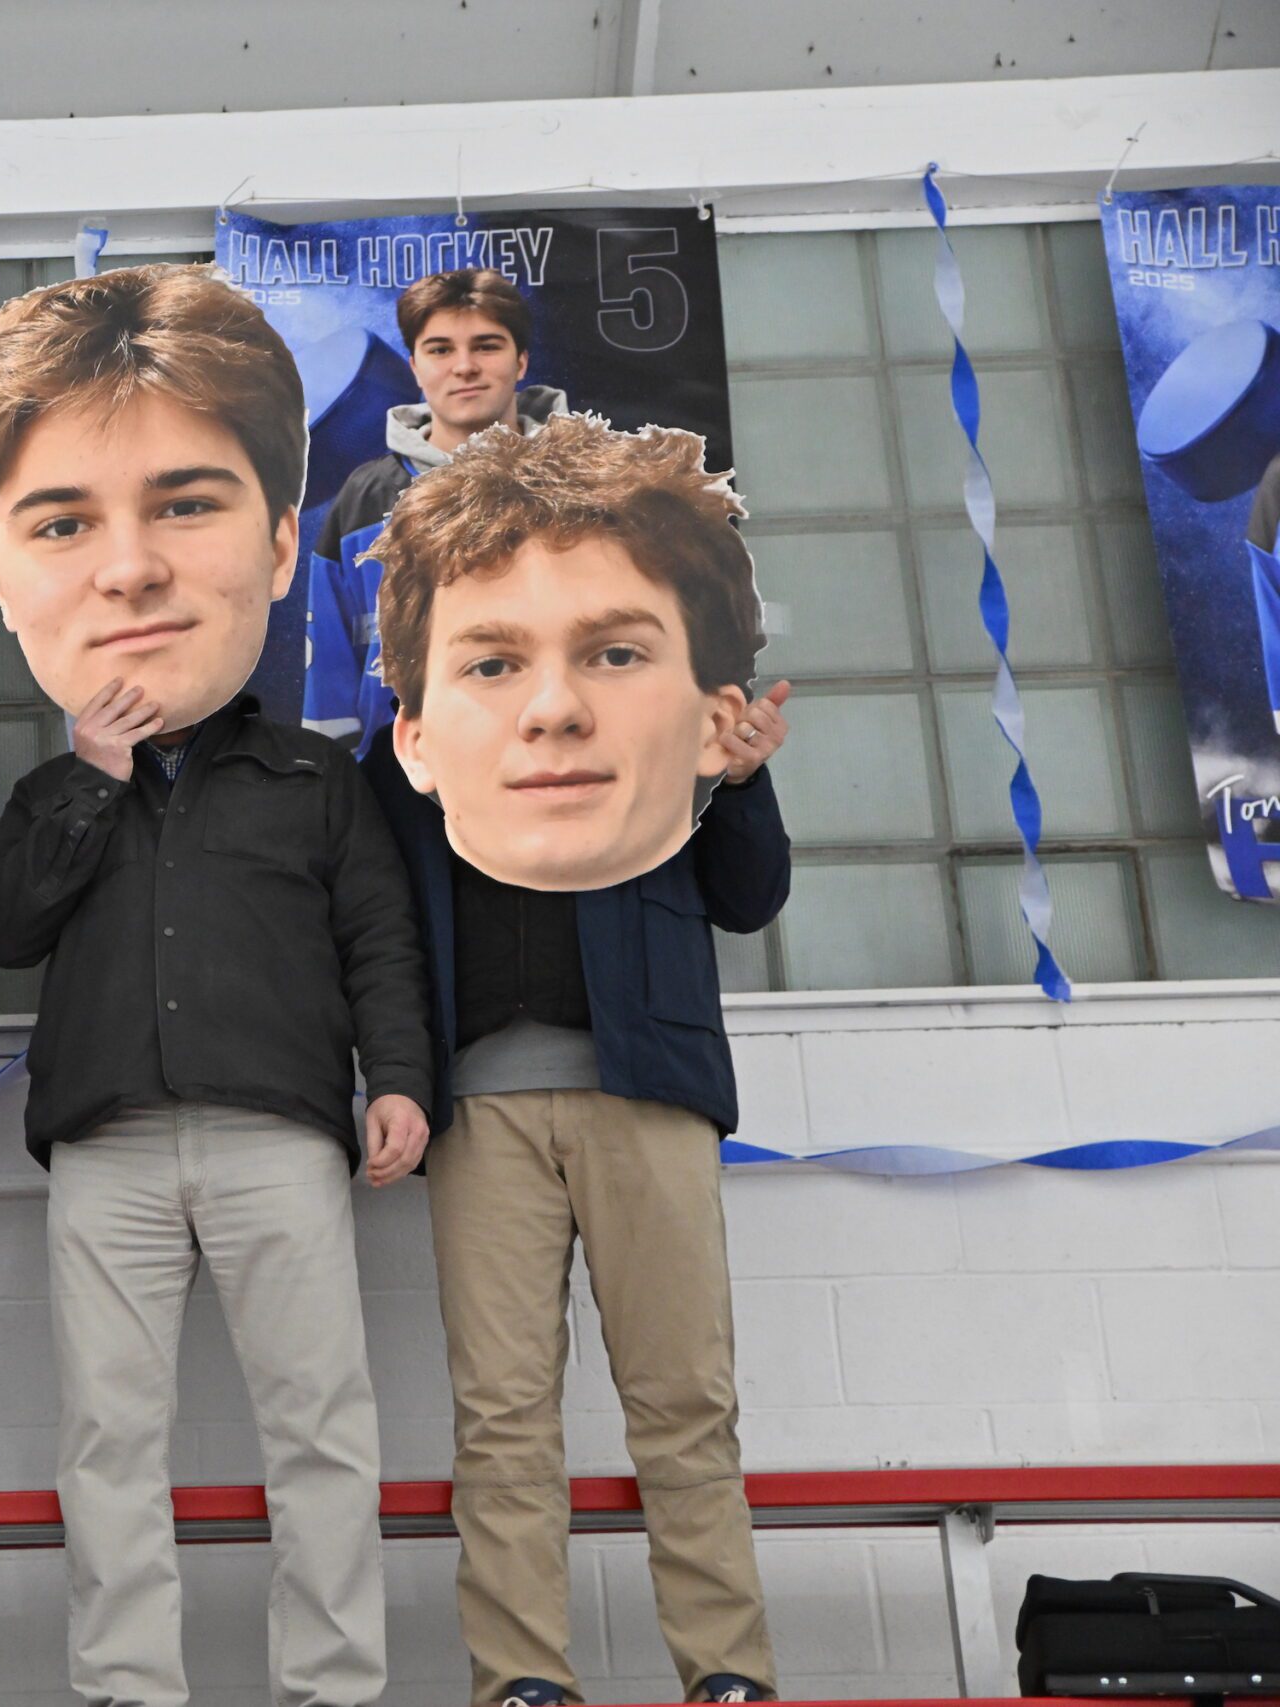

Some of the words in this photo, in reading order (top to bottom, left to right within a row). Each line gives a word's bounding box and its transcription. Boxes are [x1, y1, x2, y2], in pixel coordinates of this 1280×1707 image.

[228, 229, 350, 285] HALL
[357, 226, 555, 288] HOCKEY
[1117, 205, 1248, 269] HALL
[596, 226, 689, 352] 5
[1128, 269, 1195, 290] 2025
